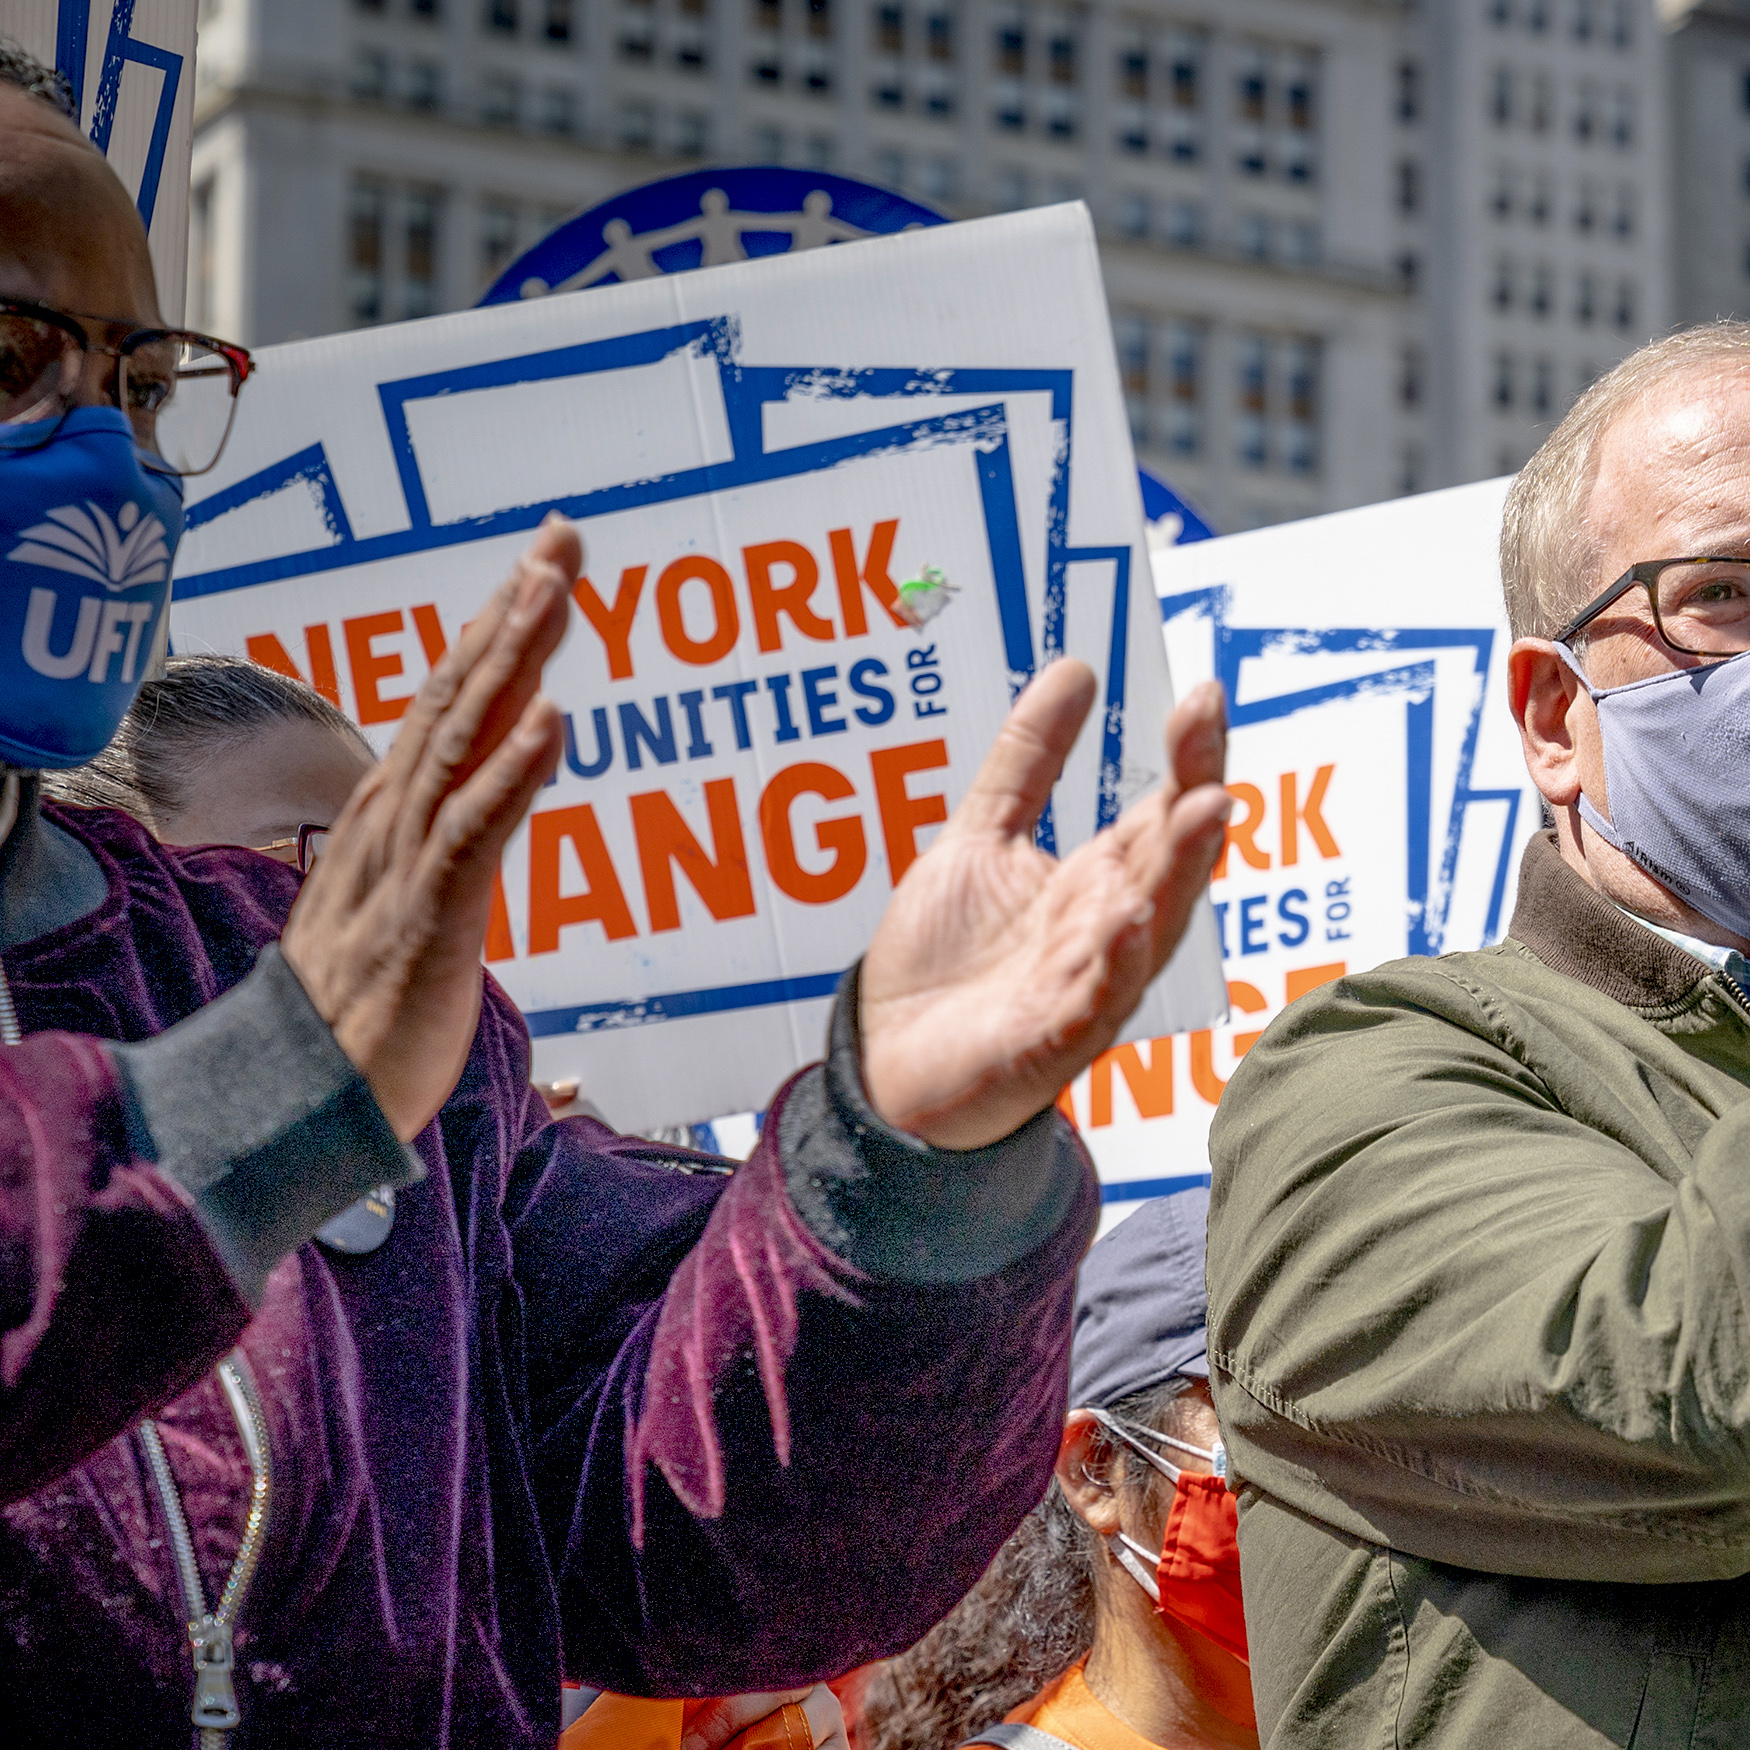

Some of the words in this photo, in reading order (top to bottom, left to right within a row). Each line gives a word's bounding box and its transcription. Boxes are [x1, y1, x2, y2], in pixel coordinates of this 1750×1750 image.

[21, 587, 153, 684] UFT
[571, 518, 911, 683] YORK
[543, 658, 895, 789] UNITIES
[906, 644, 949, 719] FOR
[1326, 876, 1352, 942] FOR
